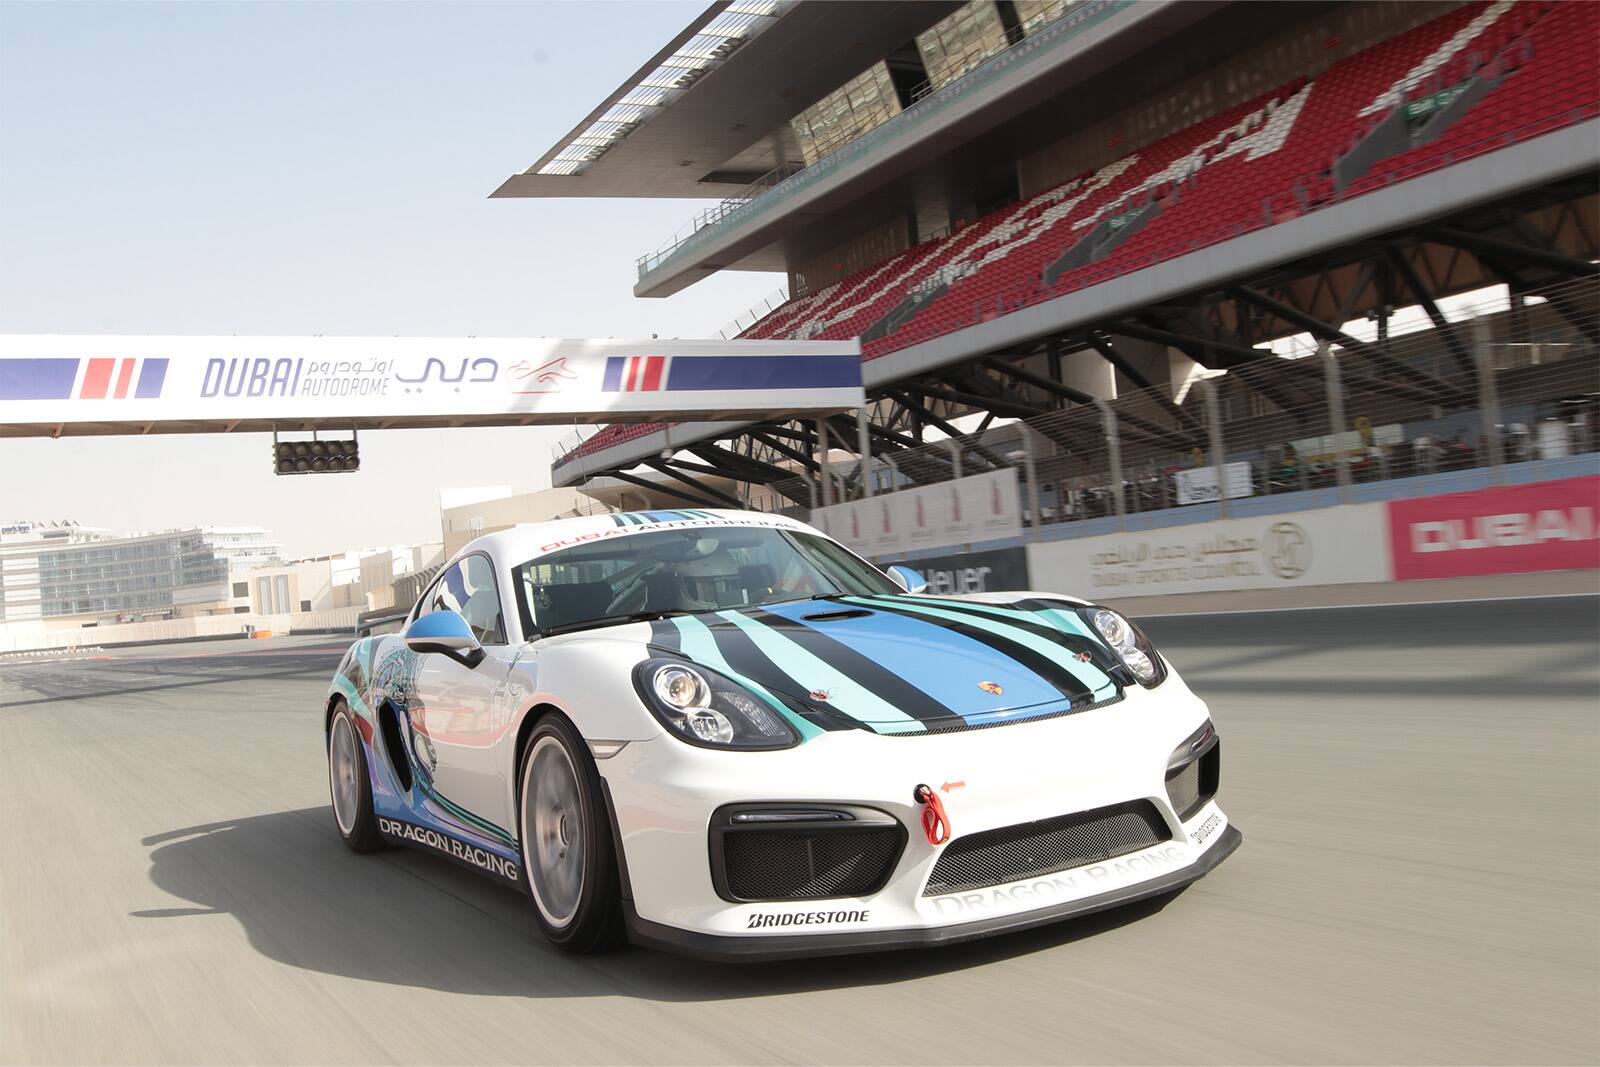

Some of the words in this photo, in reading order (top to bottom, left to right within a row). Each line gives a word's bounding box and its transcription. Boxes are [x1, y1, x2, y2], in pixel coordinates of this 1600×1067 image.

[200, 358, 303, 397] DUBAI
[301, 373, 391, 396] AUTODROME
[396, 357, 498, 393] دبي
[541, 528, 629, 552] DUBAI
[639, 519, 798, 531] AUTODROME
[1409, 506, 1595, 553] DUBAI
[379, 818, 449, 852] DRAGON
[452, 839, 519, 880] RACING
[932, 876, 1077, 917] DRAGON
[1083, 846, 1186, 882] RACING
[746, 910, 870, 929] BRIDGESTONE
